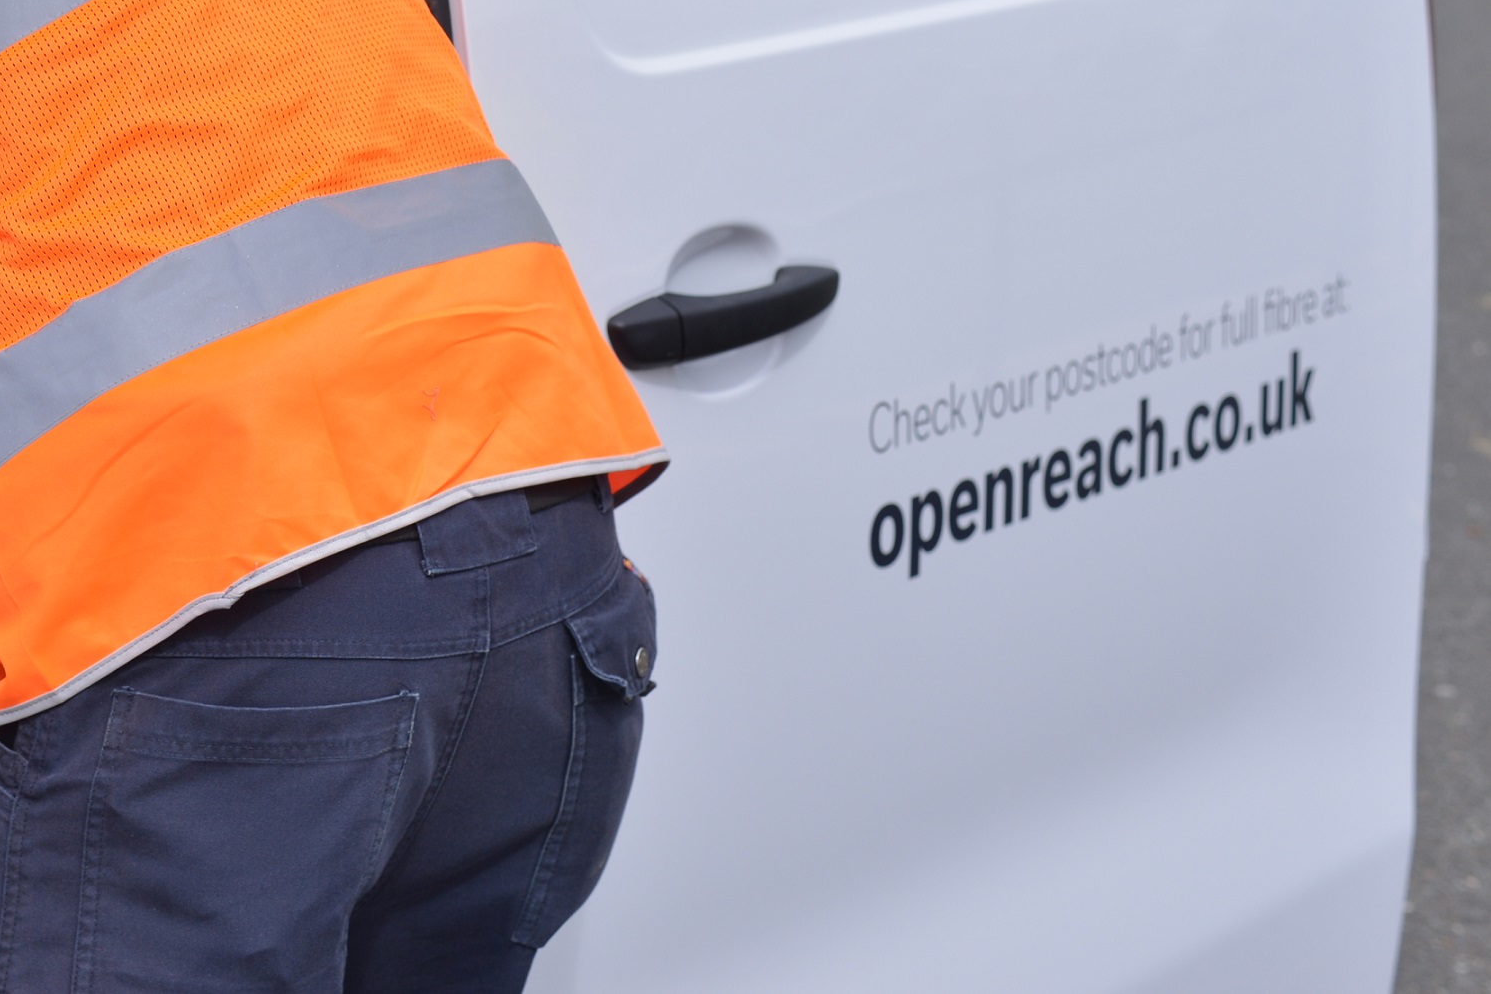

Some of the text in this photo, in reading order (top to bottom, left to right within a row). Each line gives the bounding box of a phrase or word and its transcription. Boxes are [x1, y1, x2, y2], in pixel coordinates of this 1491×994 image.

[868, 273, 1352, 454] Check your postcode for full fibre at:
[869, 348, 1316, 580] openreach.co.uk
